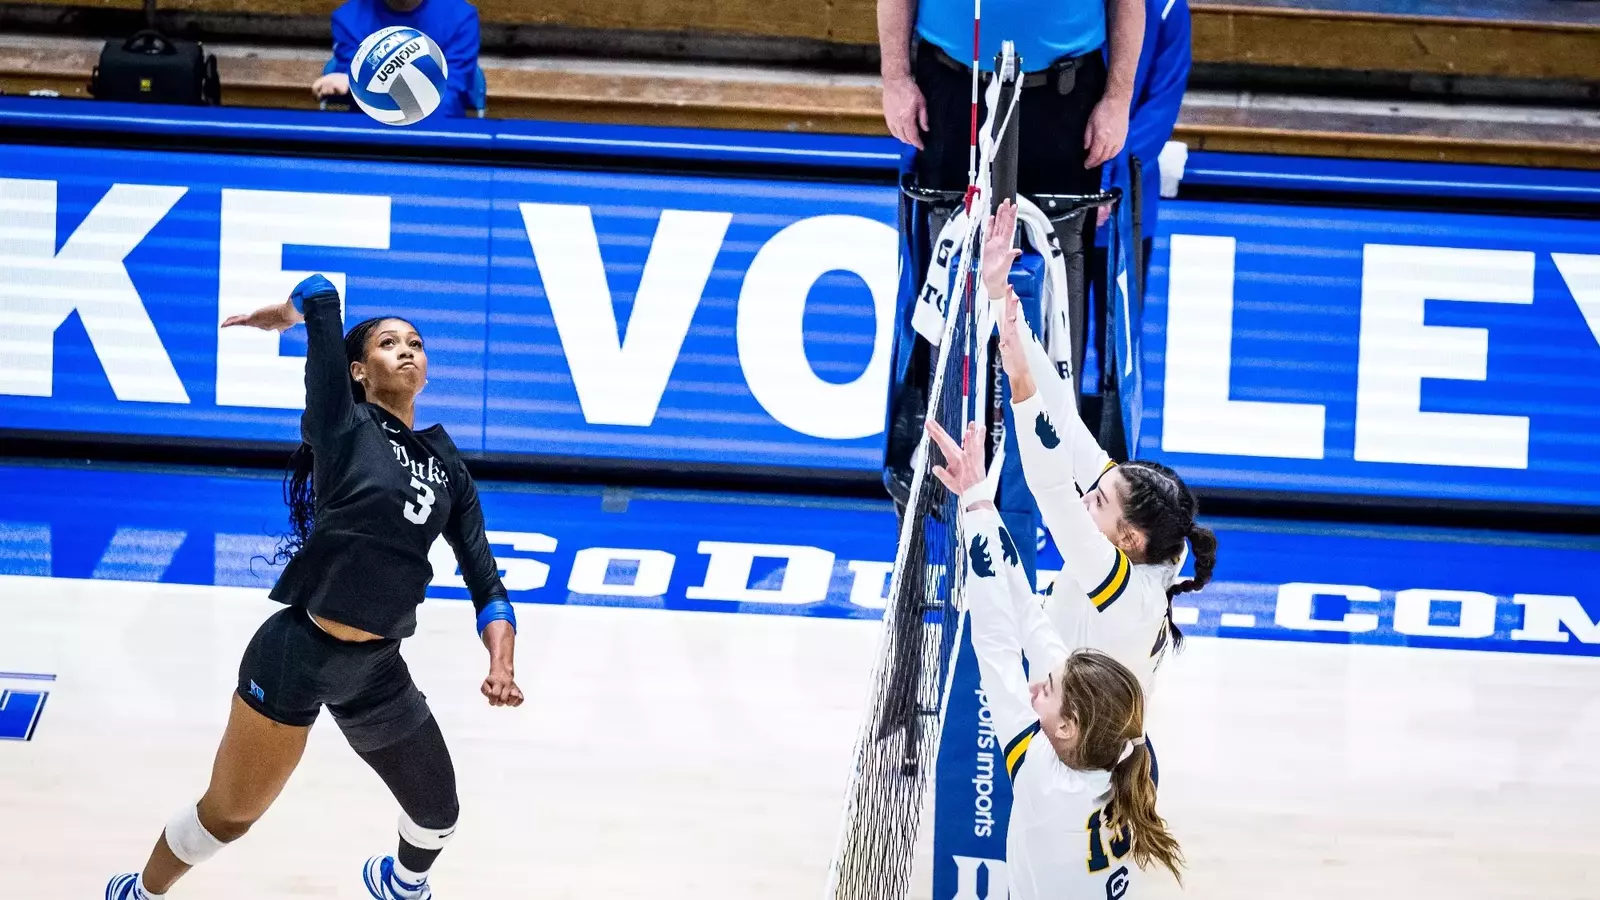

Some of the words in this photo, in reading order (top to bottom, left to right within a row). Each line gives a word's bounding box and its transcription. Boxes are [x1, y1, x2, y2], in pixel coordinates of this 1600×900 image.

[377, 41, 421, 82] molten
[389, 440, 449, 488] Duke
[403, 476, 436, 525] 3
[974, 680, 995, 748] ports
[971, 752, 996, 838] imports
